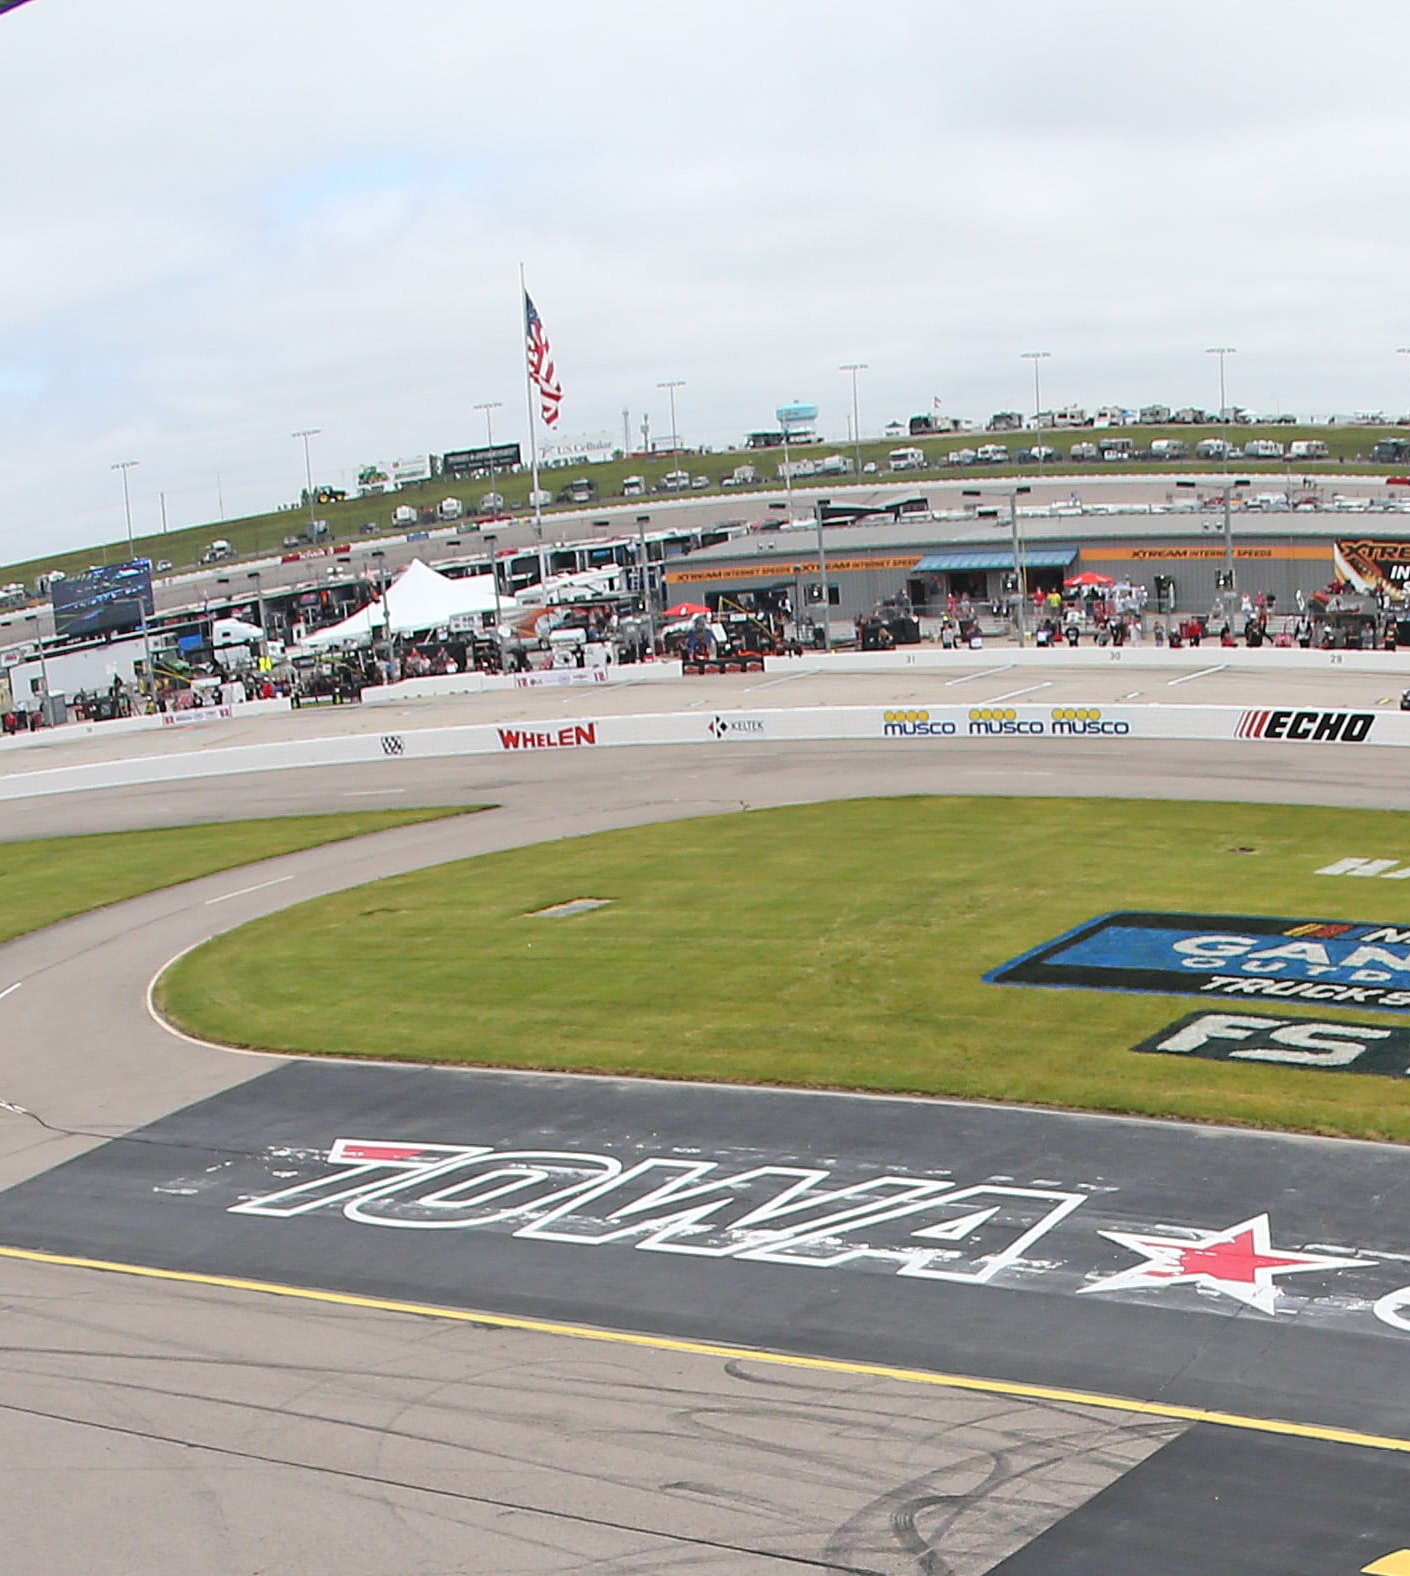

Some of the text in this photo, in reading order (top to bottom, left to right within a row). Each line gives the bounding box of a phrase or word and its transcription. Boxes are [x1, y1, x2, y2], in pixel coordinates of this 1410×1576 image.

[1132, 550, 1188, 559] XTREAM
[731, 720, 764, 733] KELTEK
[883, 720, 956, 736] musco
[969, 720, 1044, 735] musco
[1051, 720, 1129, 735] musco
[1263, 711, 1377, 742] ECHO
[1199, 973, 1389, 1004] TRUCK
[227, 1137, 1087, 1285] IOWA
